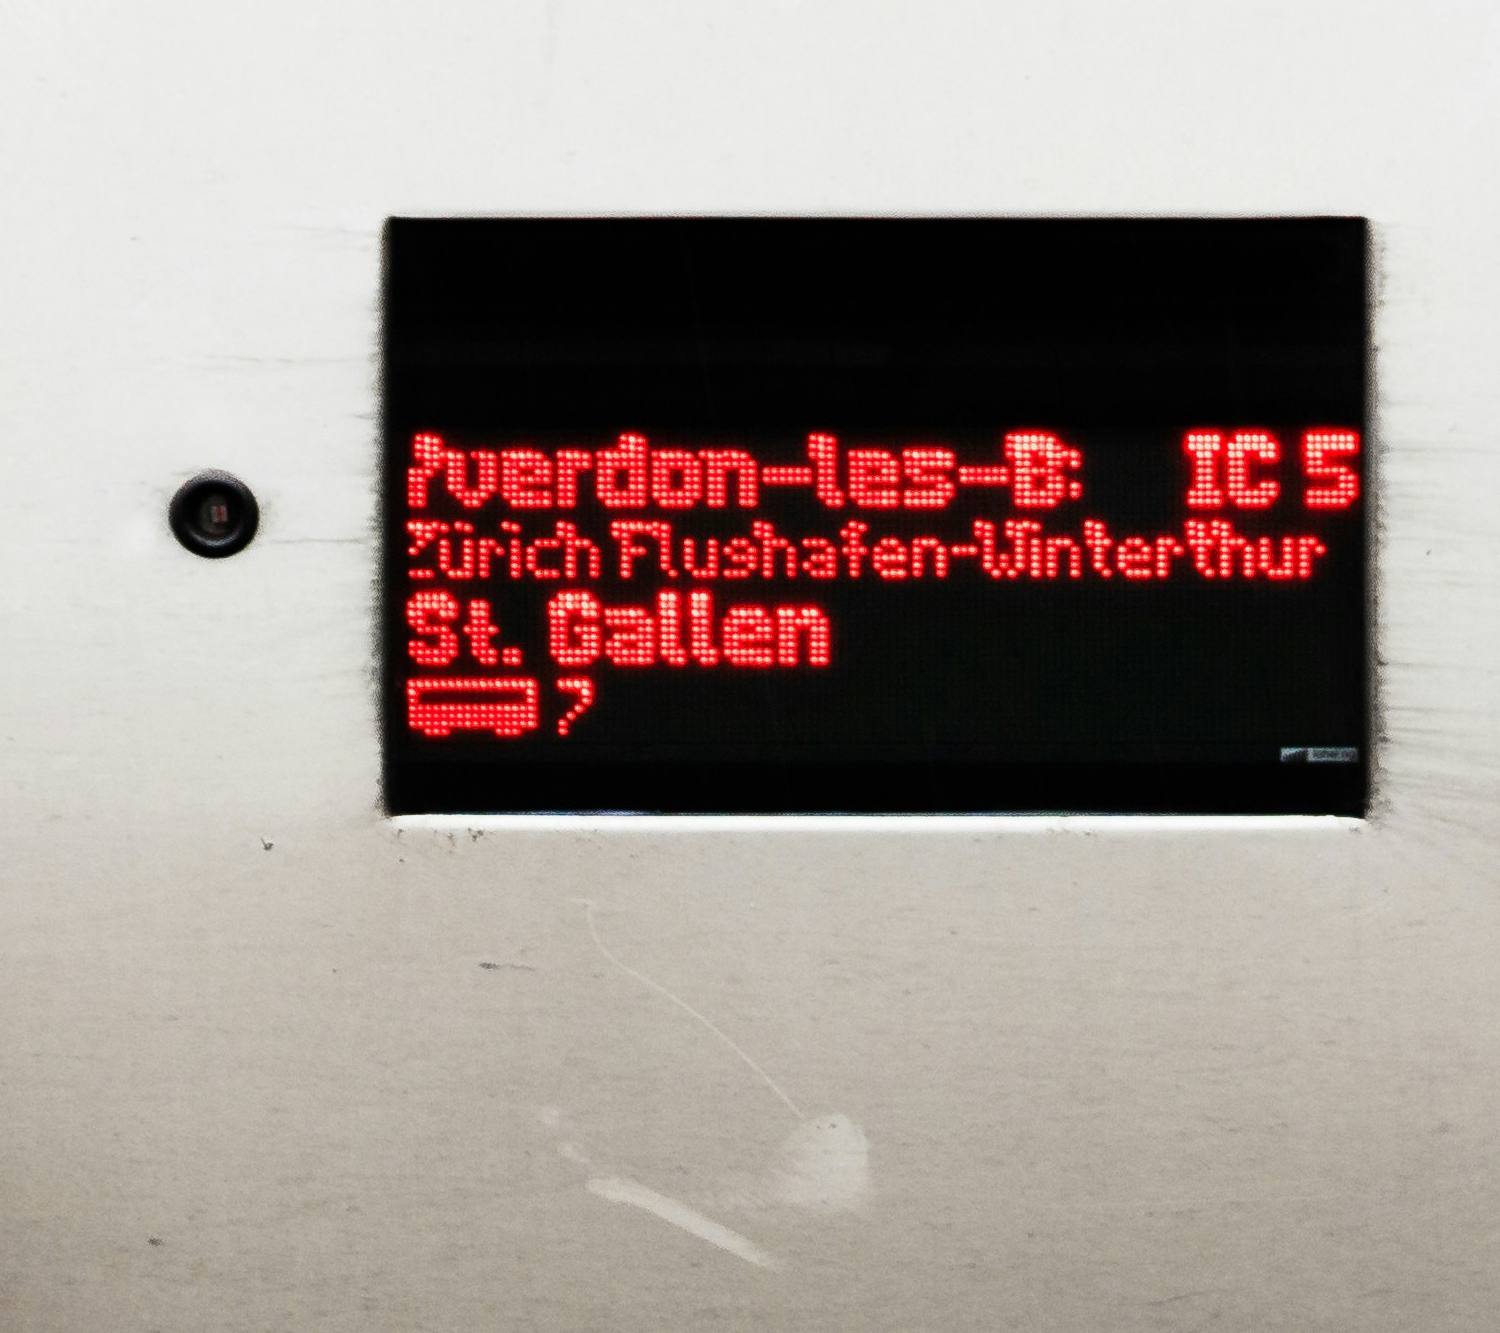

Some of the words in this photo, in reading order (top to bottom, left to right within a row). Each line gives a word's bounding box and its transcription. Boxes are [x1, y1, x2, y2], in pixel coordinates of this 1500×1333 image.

[1186, 431, 1278, 507] IC
[1304, 431, 1357, 507] 5
[406, 591, 522, 666] St.
[549, 591, 830, 666] Gallen
[556, 679, 594, 735] 7
